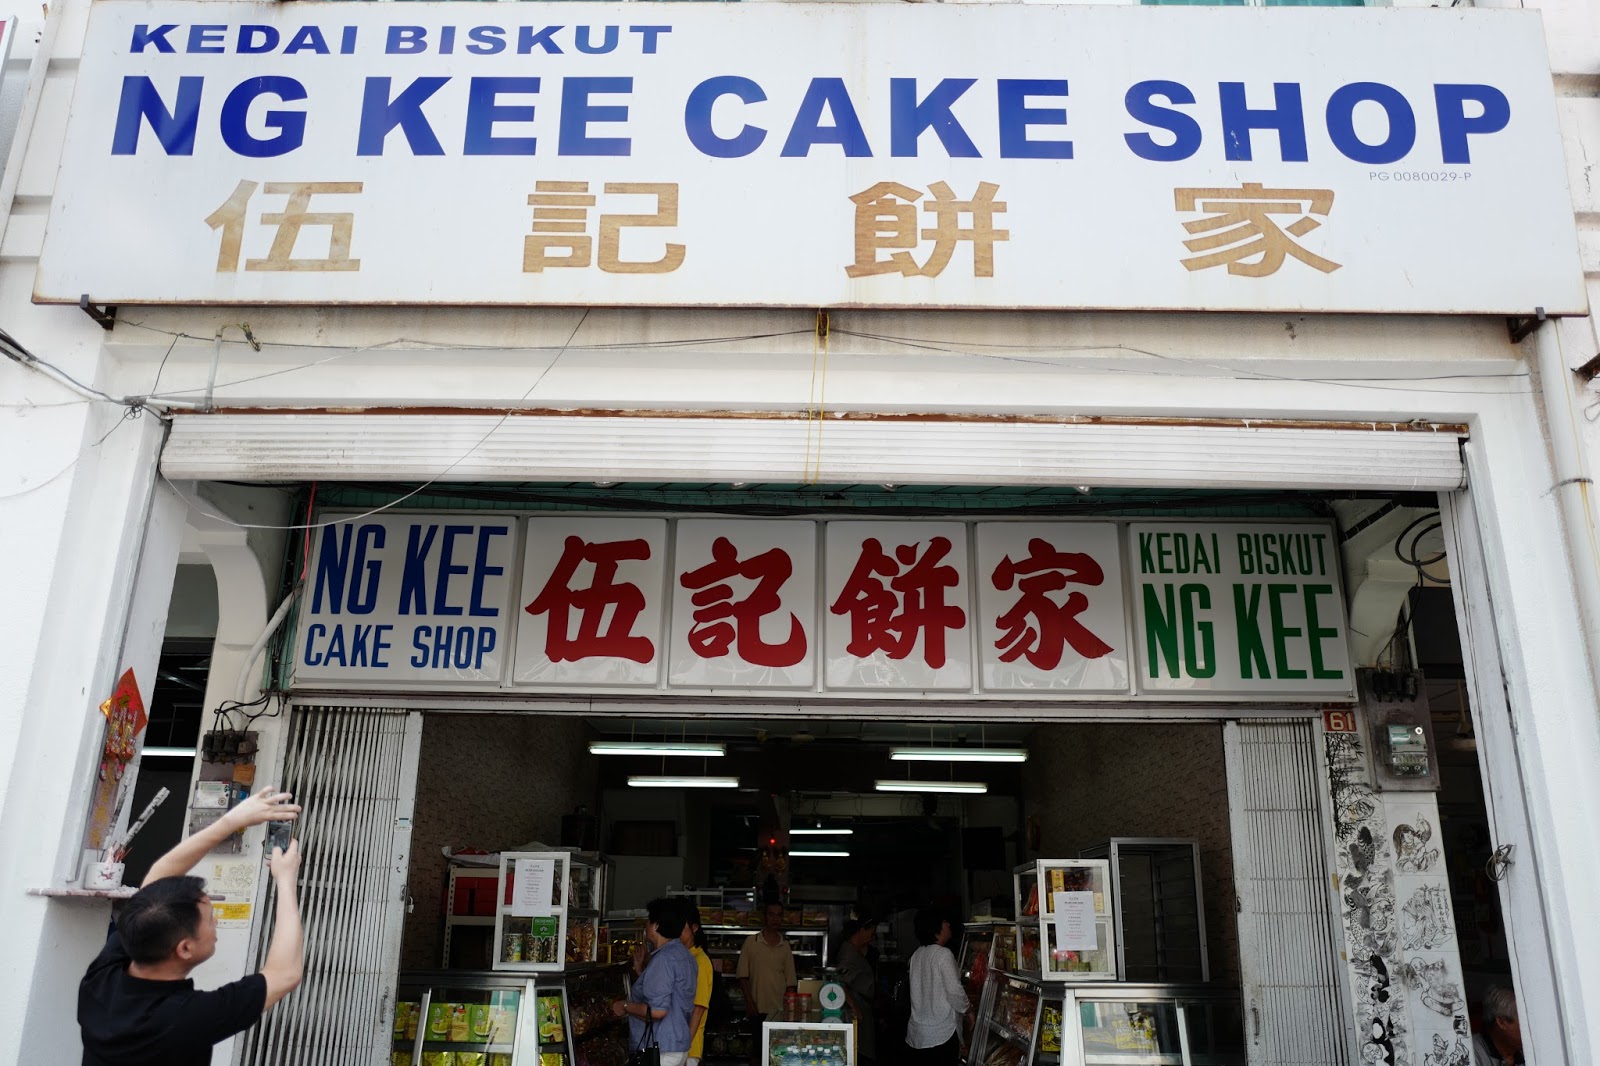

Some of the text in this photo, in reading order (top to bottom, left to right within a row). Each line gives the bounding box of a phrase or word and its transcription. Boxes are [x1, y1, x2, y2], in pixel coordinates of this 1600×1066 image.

[130, 24, 672, 55] KEDAI BISKUT
[111, 75, 1511, 165] NG KEE CAKE SHOP
[1369, 171, 1472, 182] PG 0080029-P
[311, 524, 508, 617] NG KEE
[1139, 532, 1327, 576] KEDAI BISKUT
[304, 623, 497, 670] CAKE SHOP
[1143, 583, 1344, 680] NG KEE
[1330, 712, 1353, 731] 61
